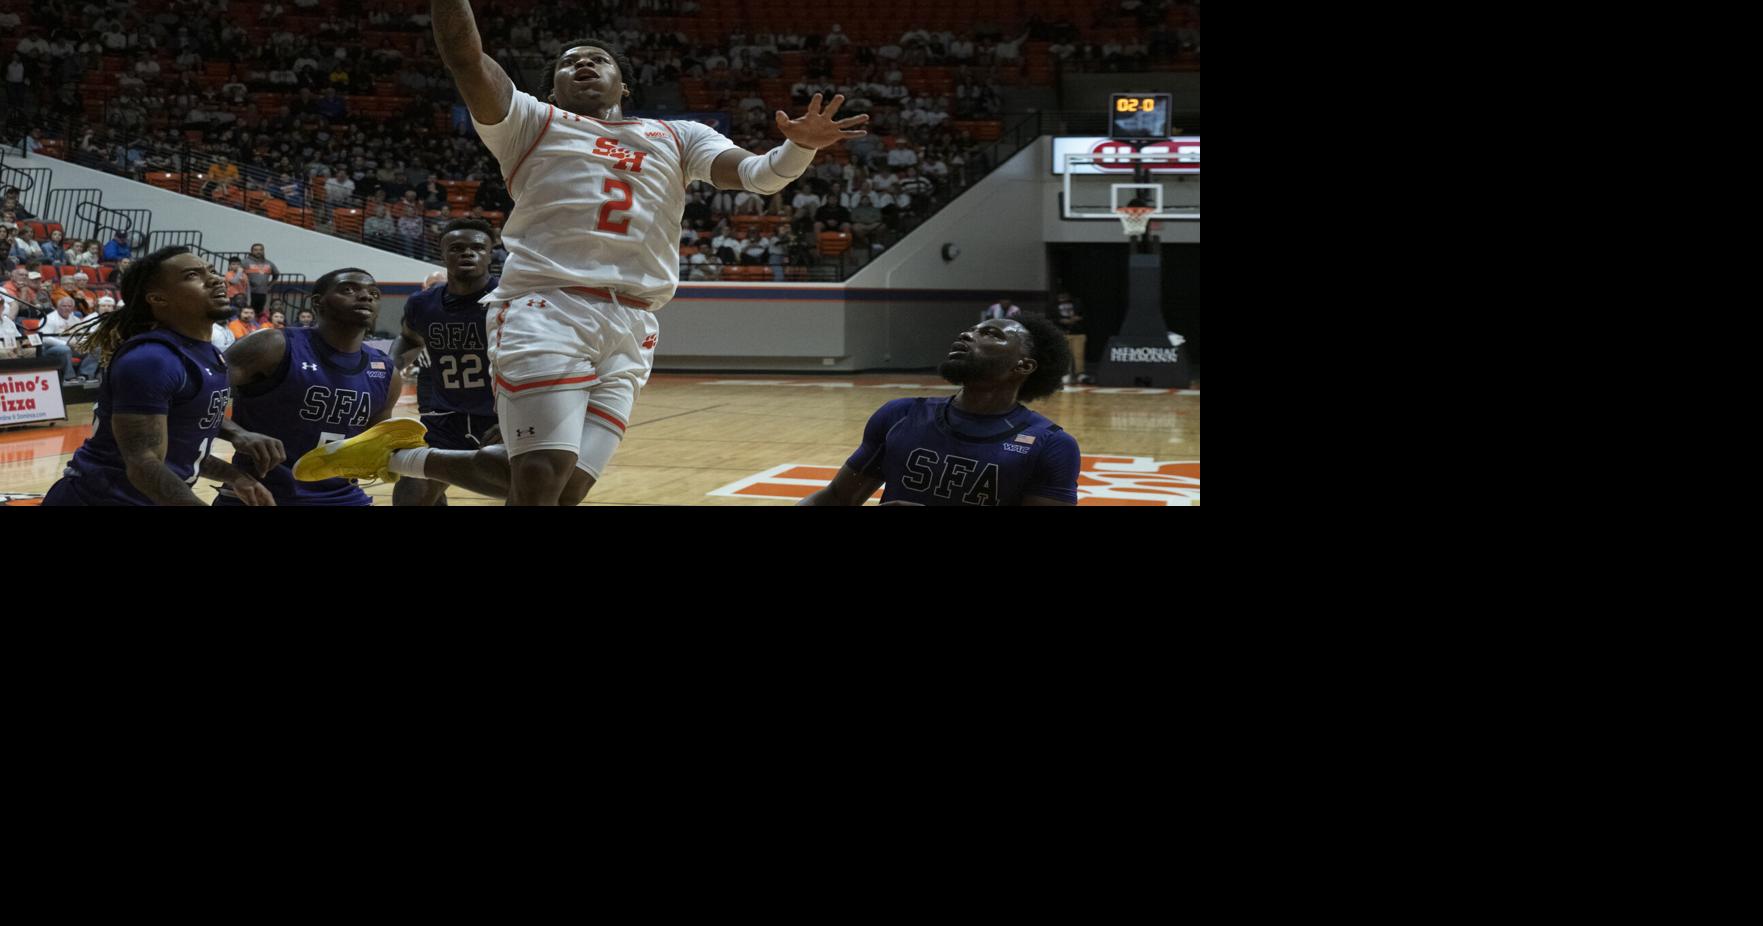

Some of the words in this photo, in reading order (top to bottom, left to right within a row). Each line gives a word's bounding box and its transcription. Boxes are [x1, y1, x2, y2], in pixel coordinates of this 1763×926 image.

[597, 177, 633, 236] 2
[428, 322, 484, 350] SFA
[439, 353, 486, 389] 22
[0, 395, 36, 412] izza
[299, 385, 371, 427] SFA
[1002, 442, 1031, 455] WAC
[901, 447, 1000, 506] SFA
